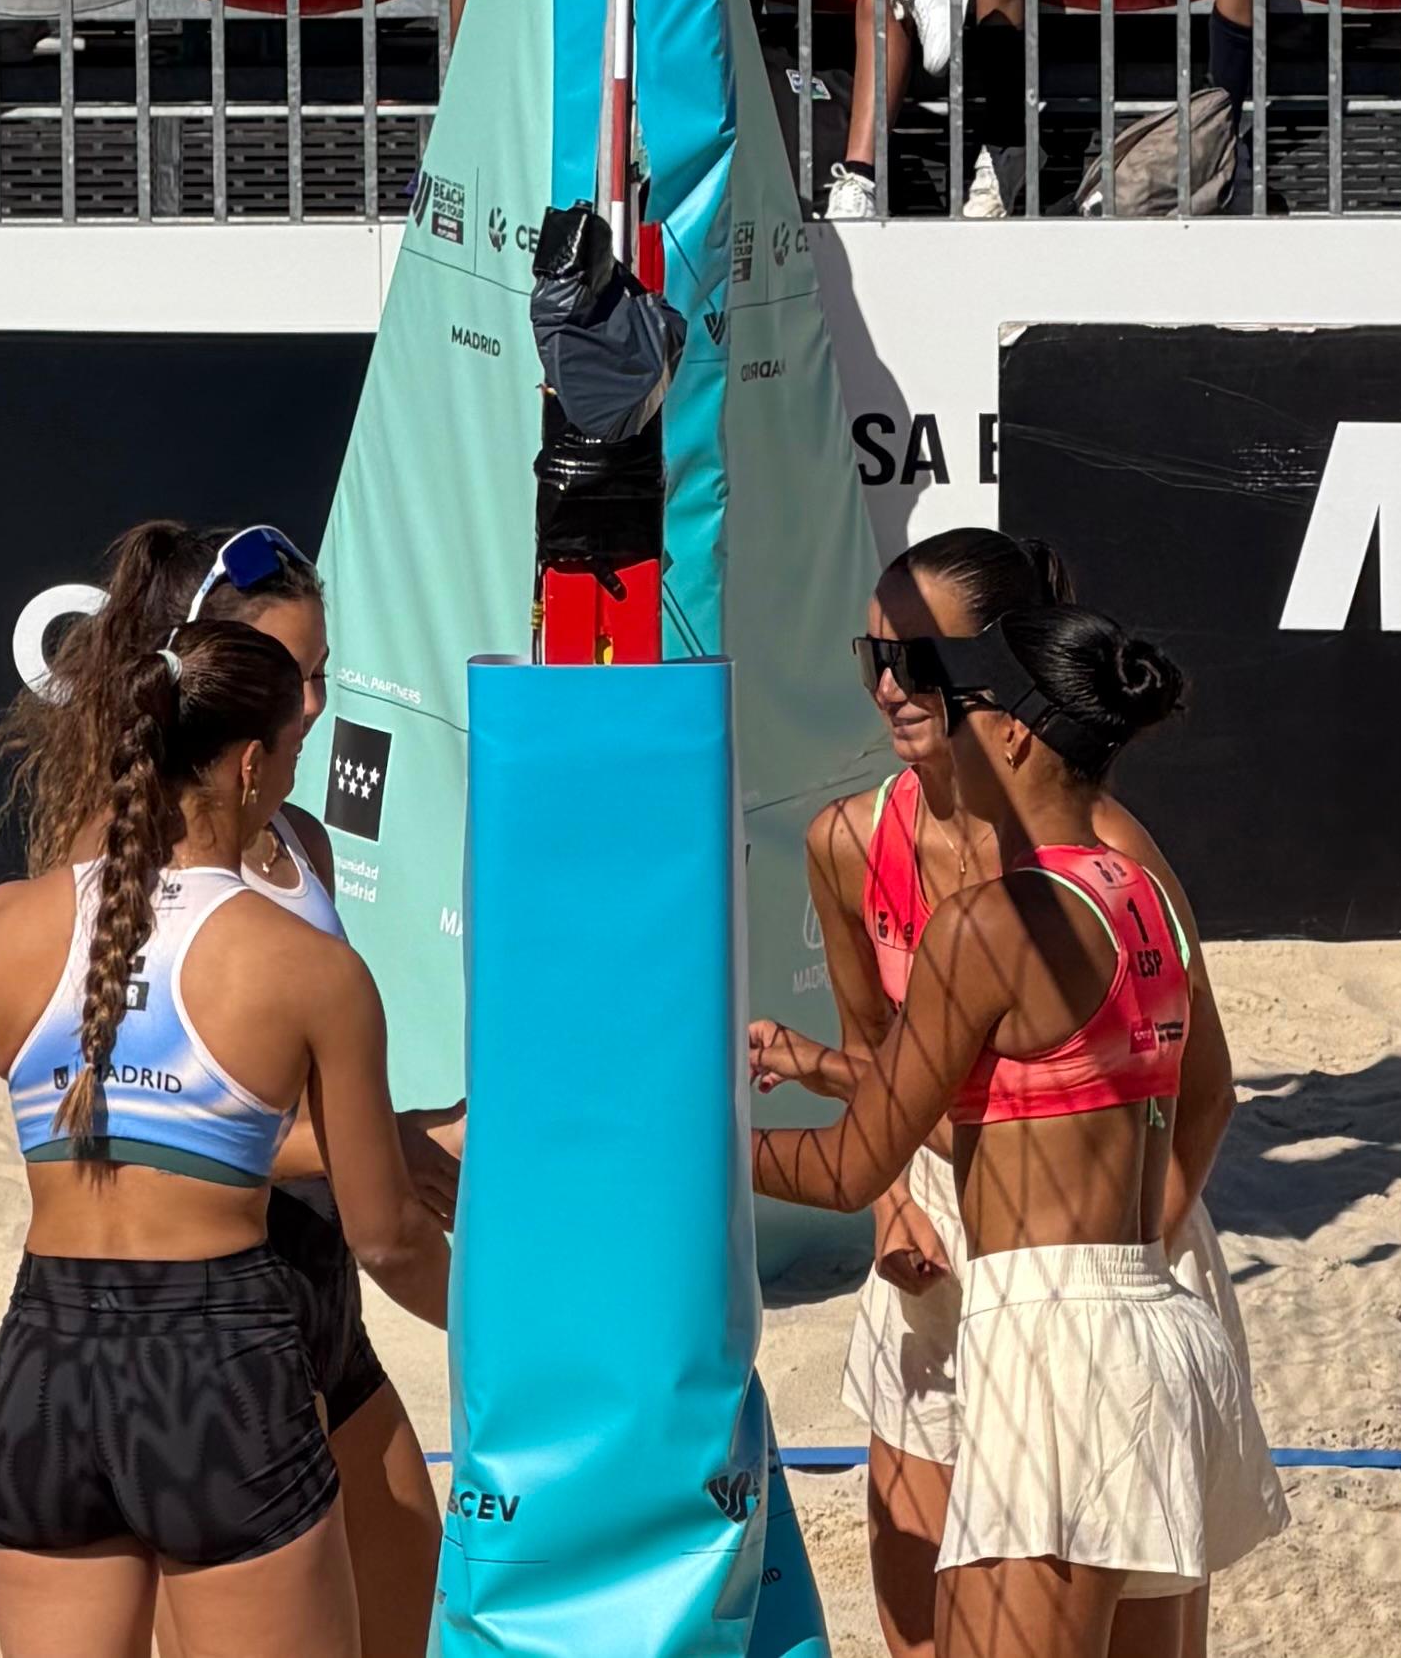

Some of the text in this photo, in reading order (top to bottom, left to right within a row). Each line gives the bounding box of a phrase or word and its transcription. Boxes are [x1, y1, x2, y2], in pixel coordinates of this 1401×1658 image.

[516, 225, 540, 254] CE
[451, 324, 501, 357] MADRID
[1127, 897, 1150, 944] 1
[1137, 948, 1162, 979] ESP
[107, 1063, 183, 1094] ADRID
[458, 1491, 521, 1523] CEV
